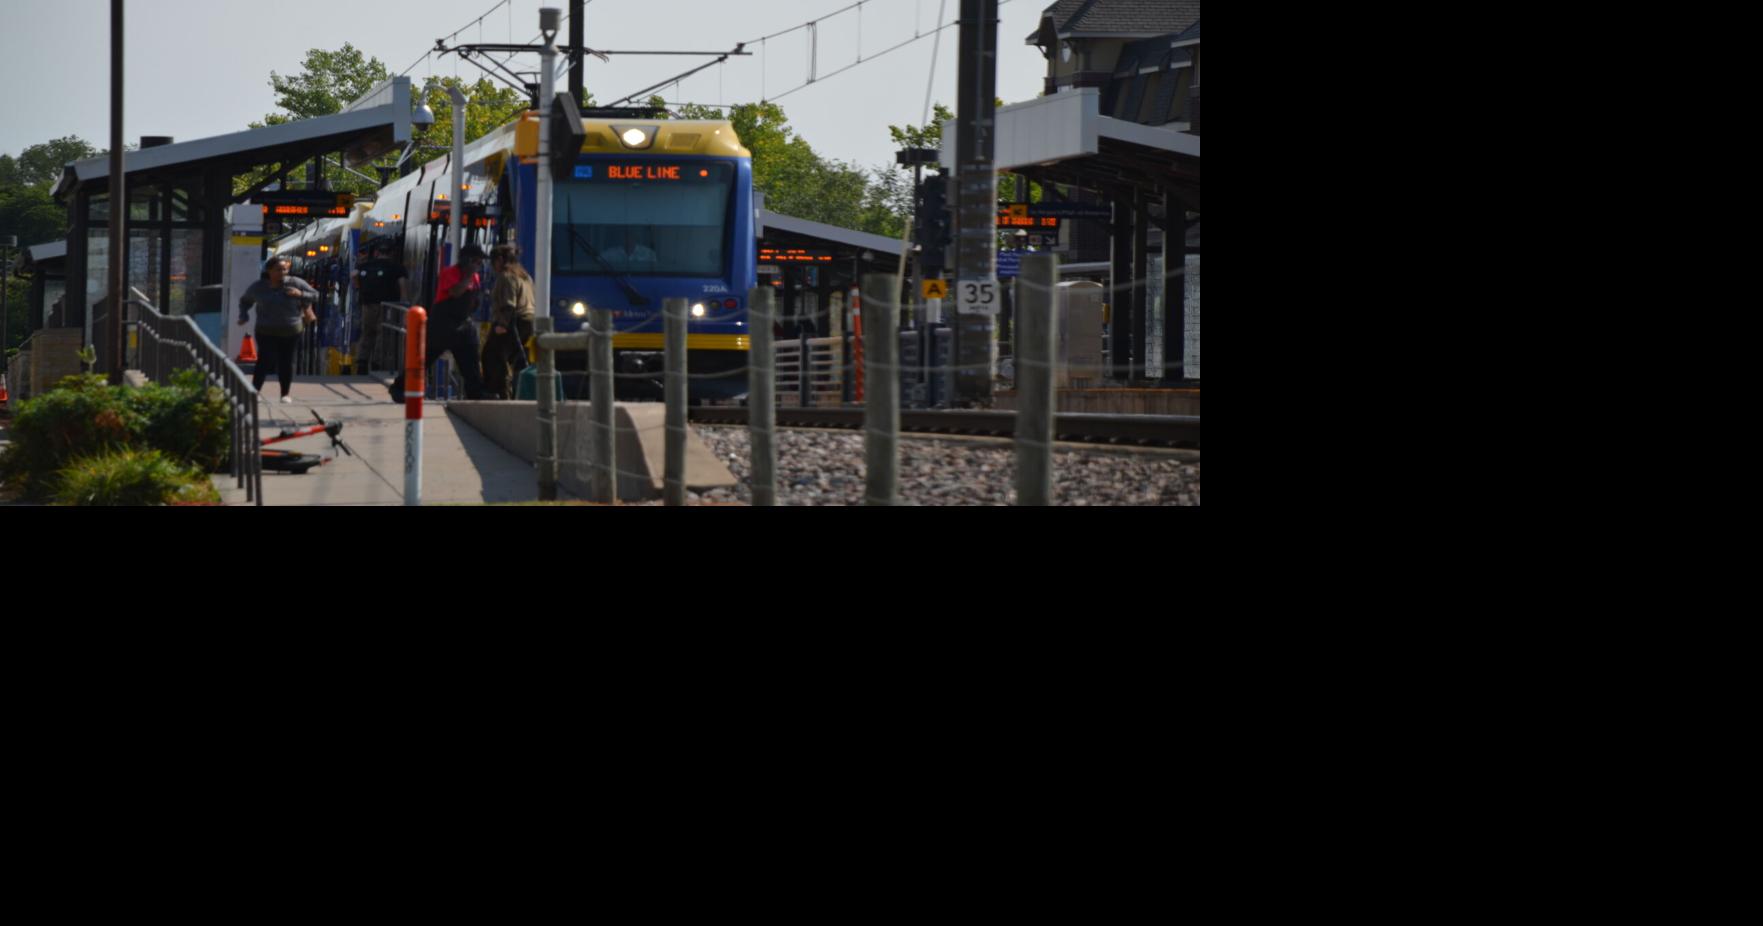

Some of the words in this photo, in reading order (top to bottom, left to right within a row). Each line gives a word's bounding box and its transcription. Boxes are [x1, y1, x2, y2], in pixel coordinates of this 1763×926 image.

[608, 166, 643, 179] BLUE
[647, 166, 681, 179] LINE
[928, 283, 942, 295] A
[965, 284, 994, 304] 35
